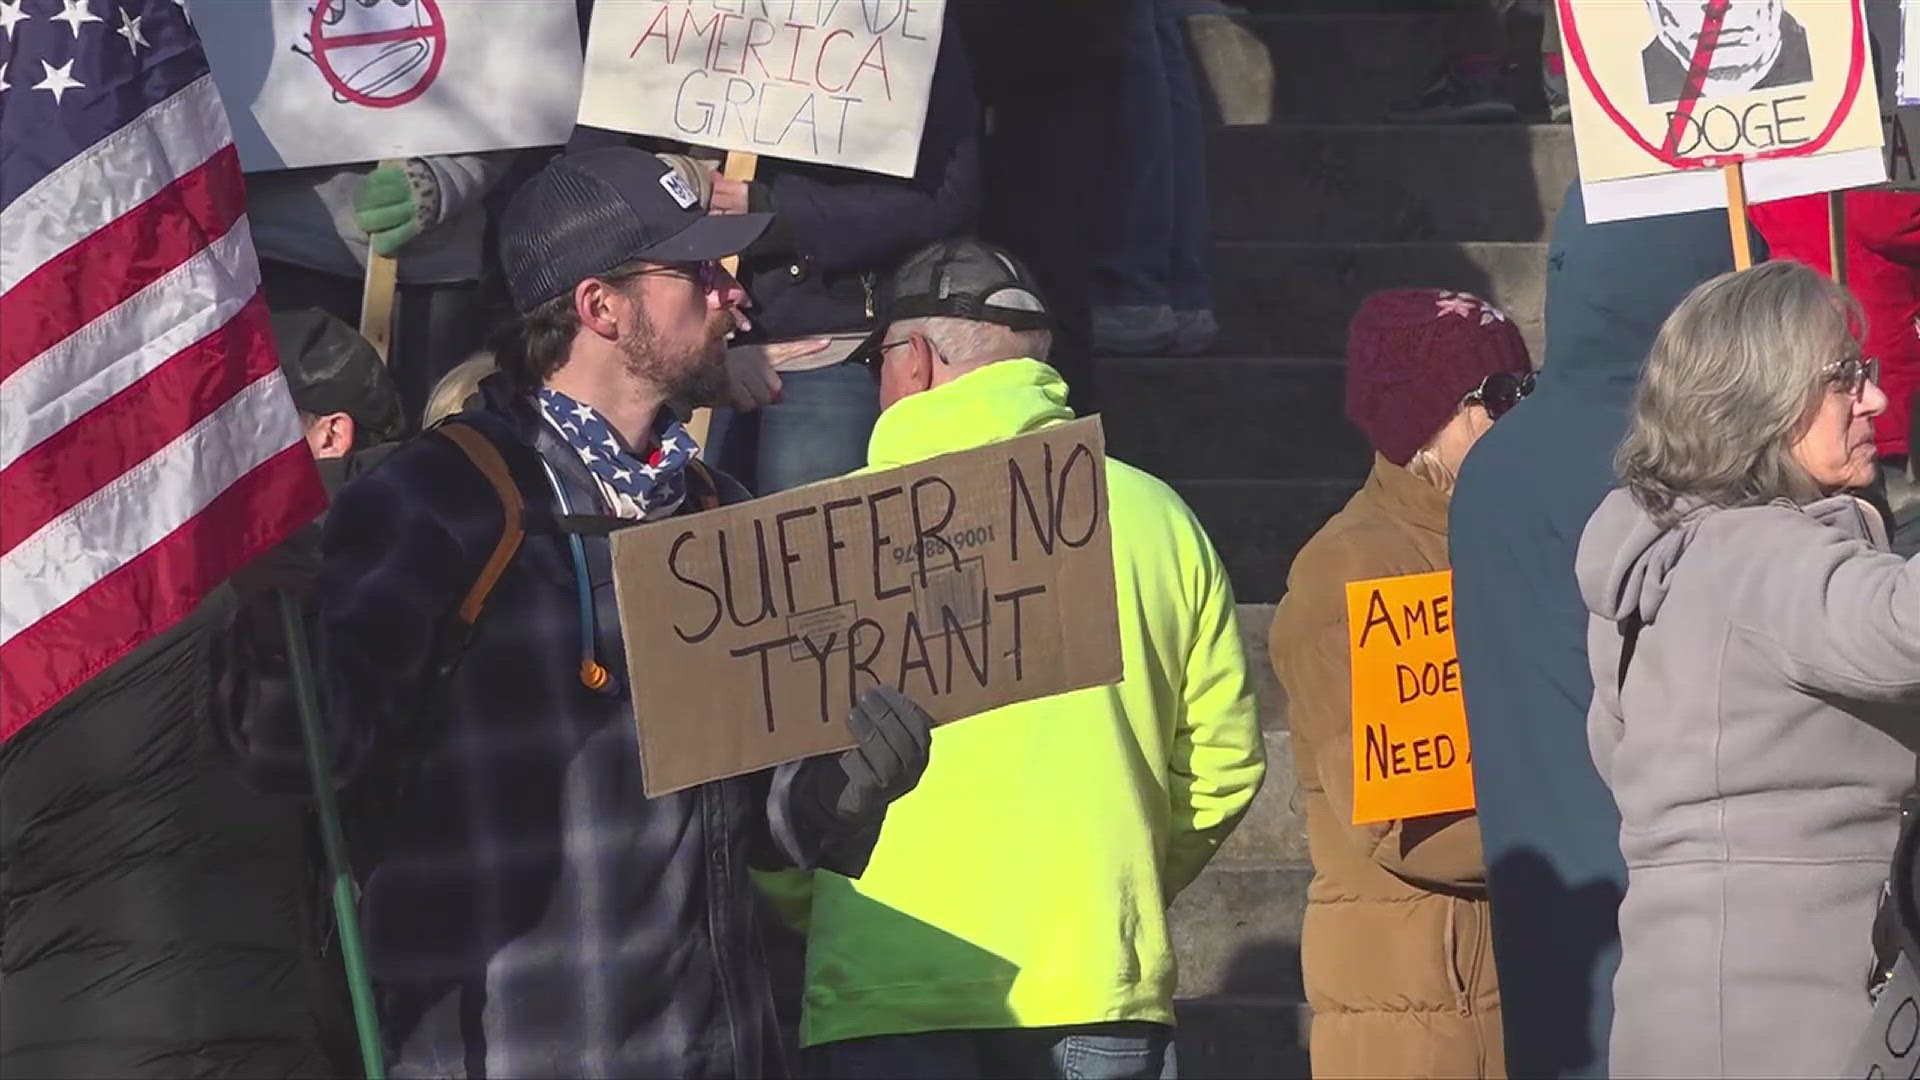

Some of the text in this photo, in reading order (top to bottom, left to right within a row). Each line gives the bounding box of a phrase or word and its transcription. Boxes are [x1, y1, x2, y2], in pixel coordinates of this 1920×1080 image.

[629, 4, 892, 101] AMERICA
[674, 69, 863, 155] GREAT
[1665, 95, 1811, 157] DOGE
[668, 442, 1100, 643] SUFFER NO
[1358, 589, 1451, 648] AME
[730, 585, 1046, 733] TYRANT
[1396, 658, 1460, 704] DOE
[1364, 723, 1456, 782] NEED
